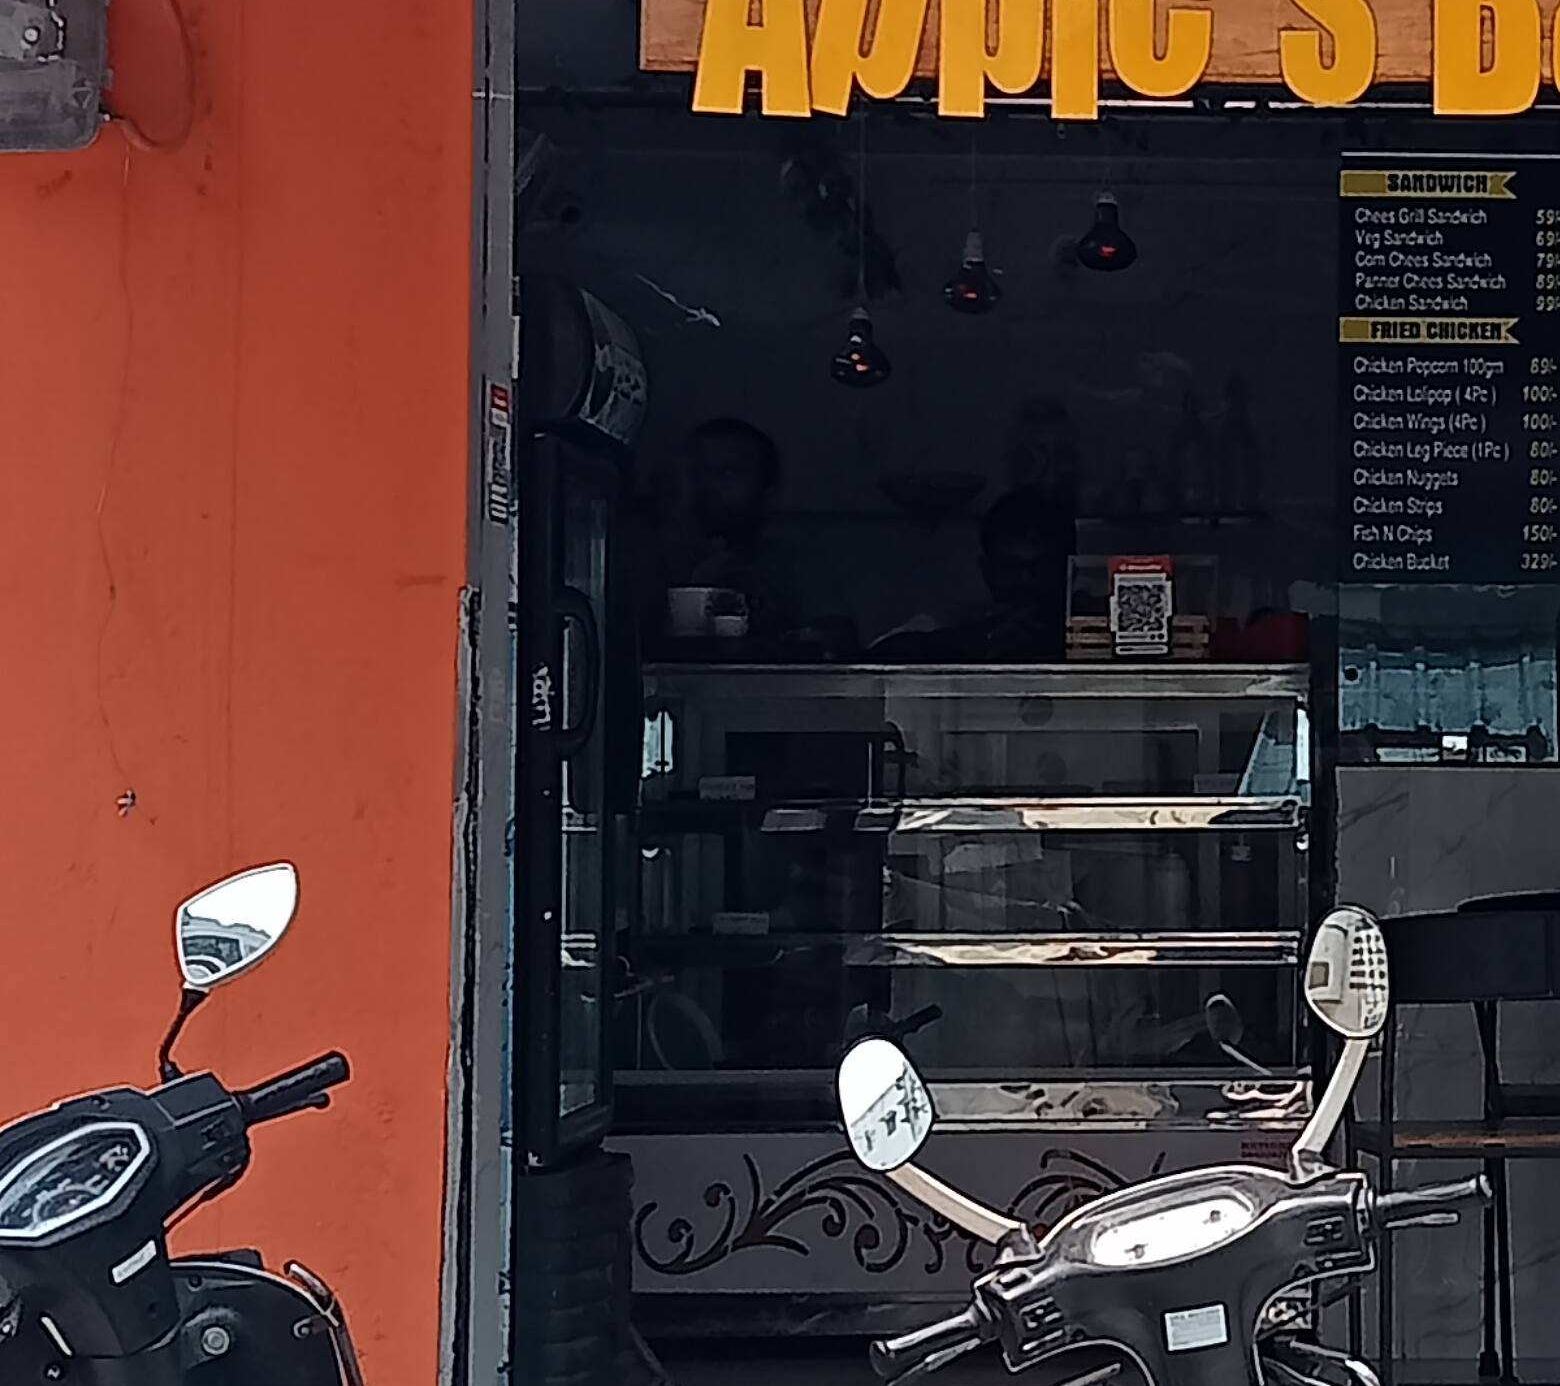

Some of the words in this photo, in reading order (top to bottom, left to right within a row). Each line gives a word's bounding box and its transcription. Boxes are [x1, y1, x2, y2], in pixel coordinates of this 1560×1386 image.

[1386, 174, 1489, 192] SANDWICH
[1427, 208, 1488, 224] Sandwich
[1355, 230, 1381, 249] Veg
[1384, 230, 1444, 245] Sandwich
[1432, 251, 1492, 267] Sandwich
[1447, 273, 1506, 288] Sandwich
[1355, 294, 1405, 310] Chicken
[1409, 294, 1468, 310] Sandwich
[1371, 321, 1421, 340] FRIED
[1426, 321, 1502, 340] CHICKEN
[1353, 356, 1403, 374] Chicken
[1353, 384, 1404, 402] Chicken
[1353, 412, 1404, 429] Chicken
[1407, 413, 1446, 434] Wings
[1353, 440, 1404, 458] Chicken
[1407, 441, 1430, 462] Leg
[1353, 468, 1403, 485] Chicken
[1353, 496, 1403, 513] Chicken
[1353, 524, 1379, 541] Fish
[1397, 524, 1433, 545] Chips
[1353, 552, 1403, 569] Chicken
[1407, 552, 1450, 569] Bucket
